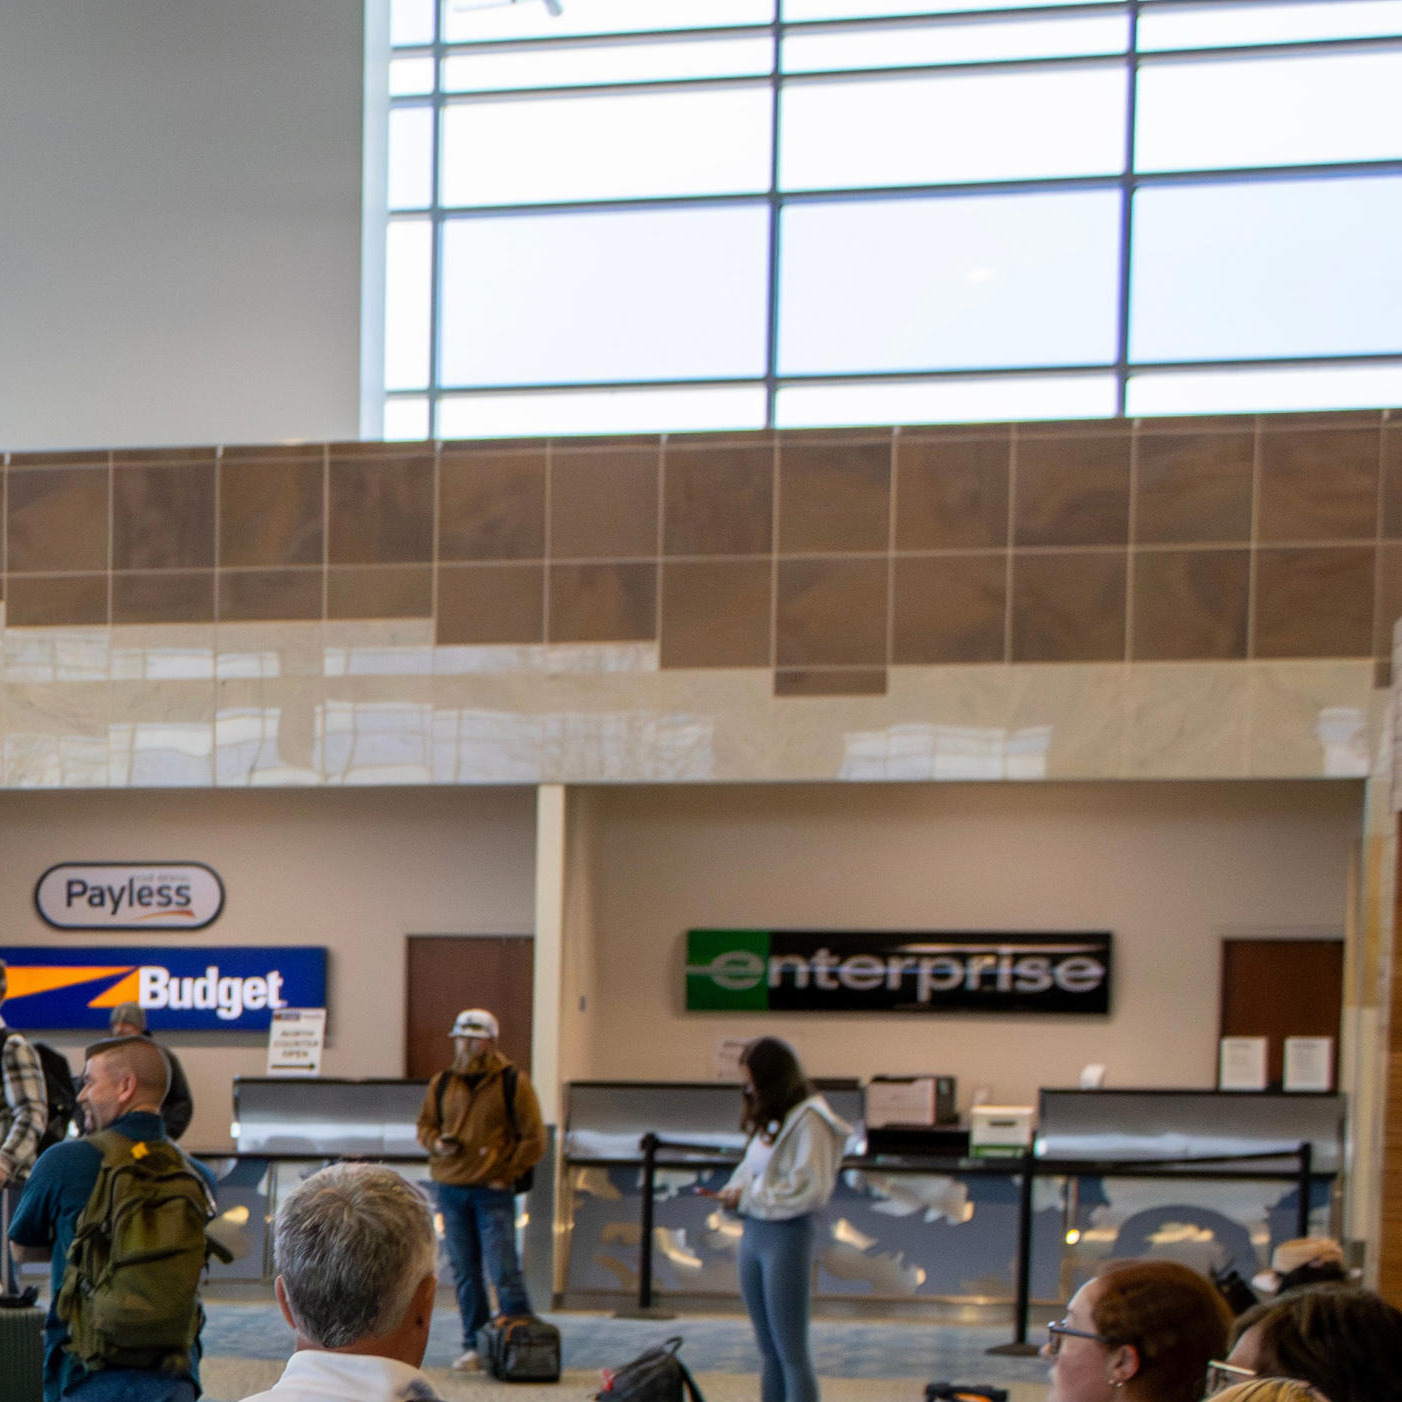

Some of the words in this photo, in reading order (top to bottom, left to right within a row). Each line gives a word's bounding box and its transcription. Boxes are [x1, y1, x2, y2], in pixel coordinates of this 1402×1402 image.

[66, 878, 191, 916] Payless
[138, 966, 284, 1020] Budget
[690, 948, 1105, 1003] enterprise
